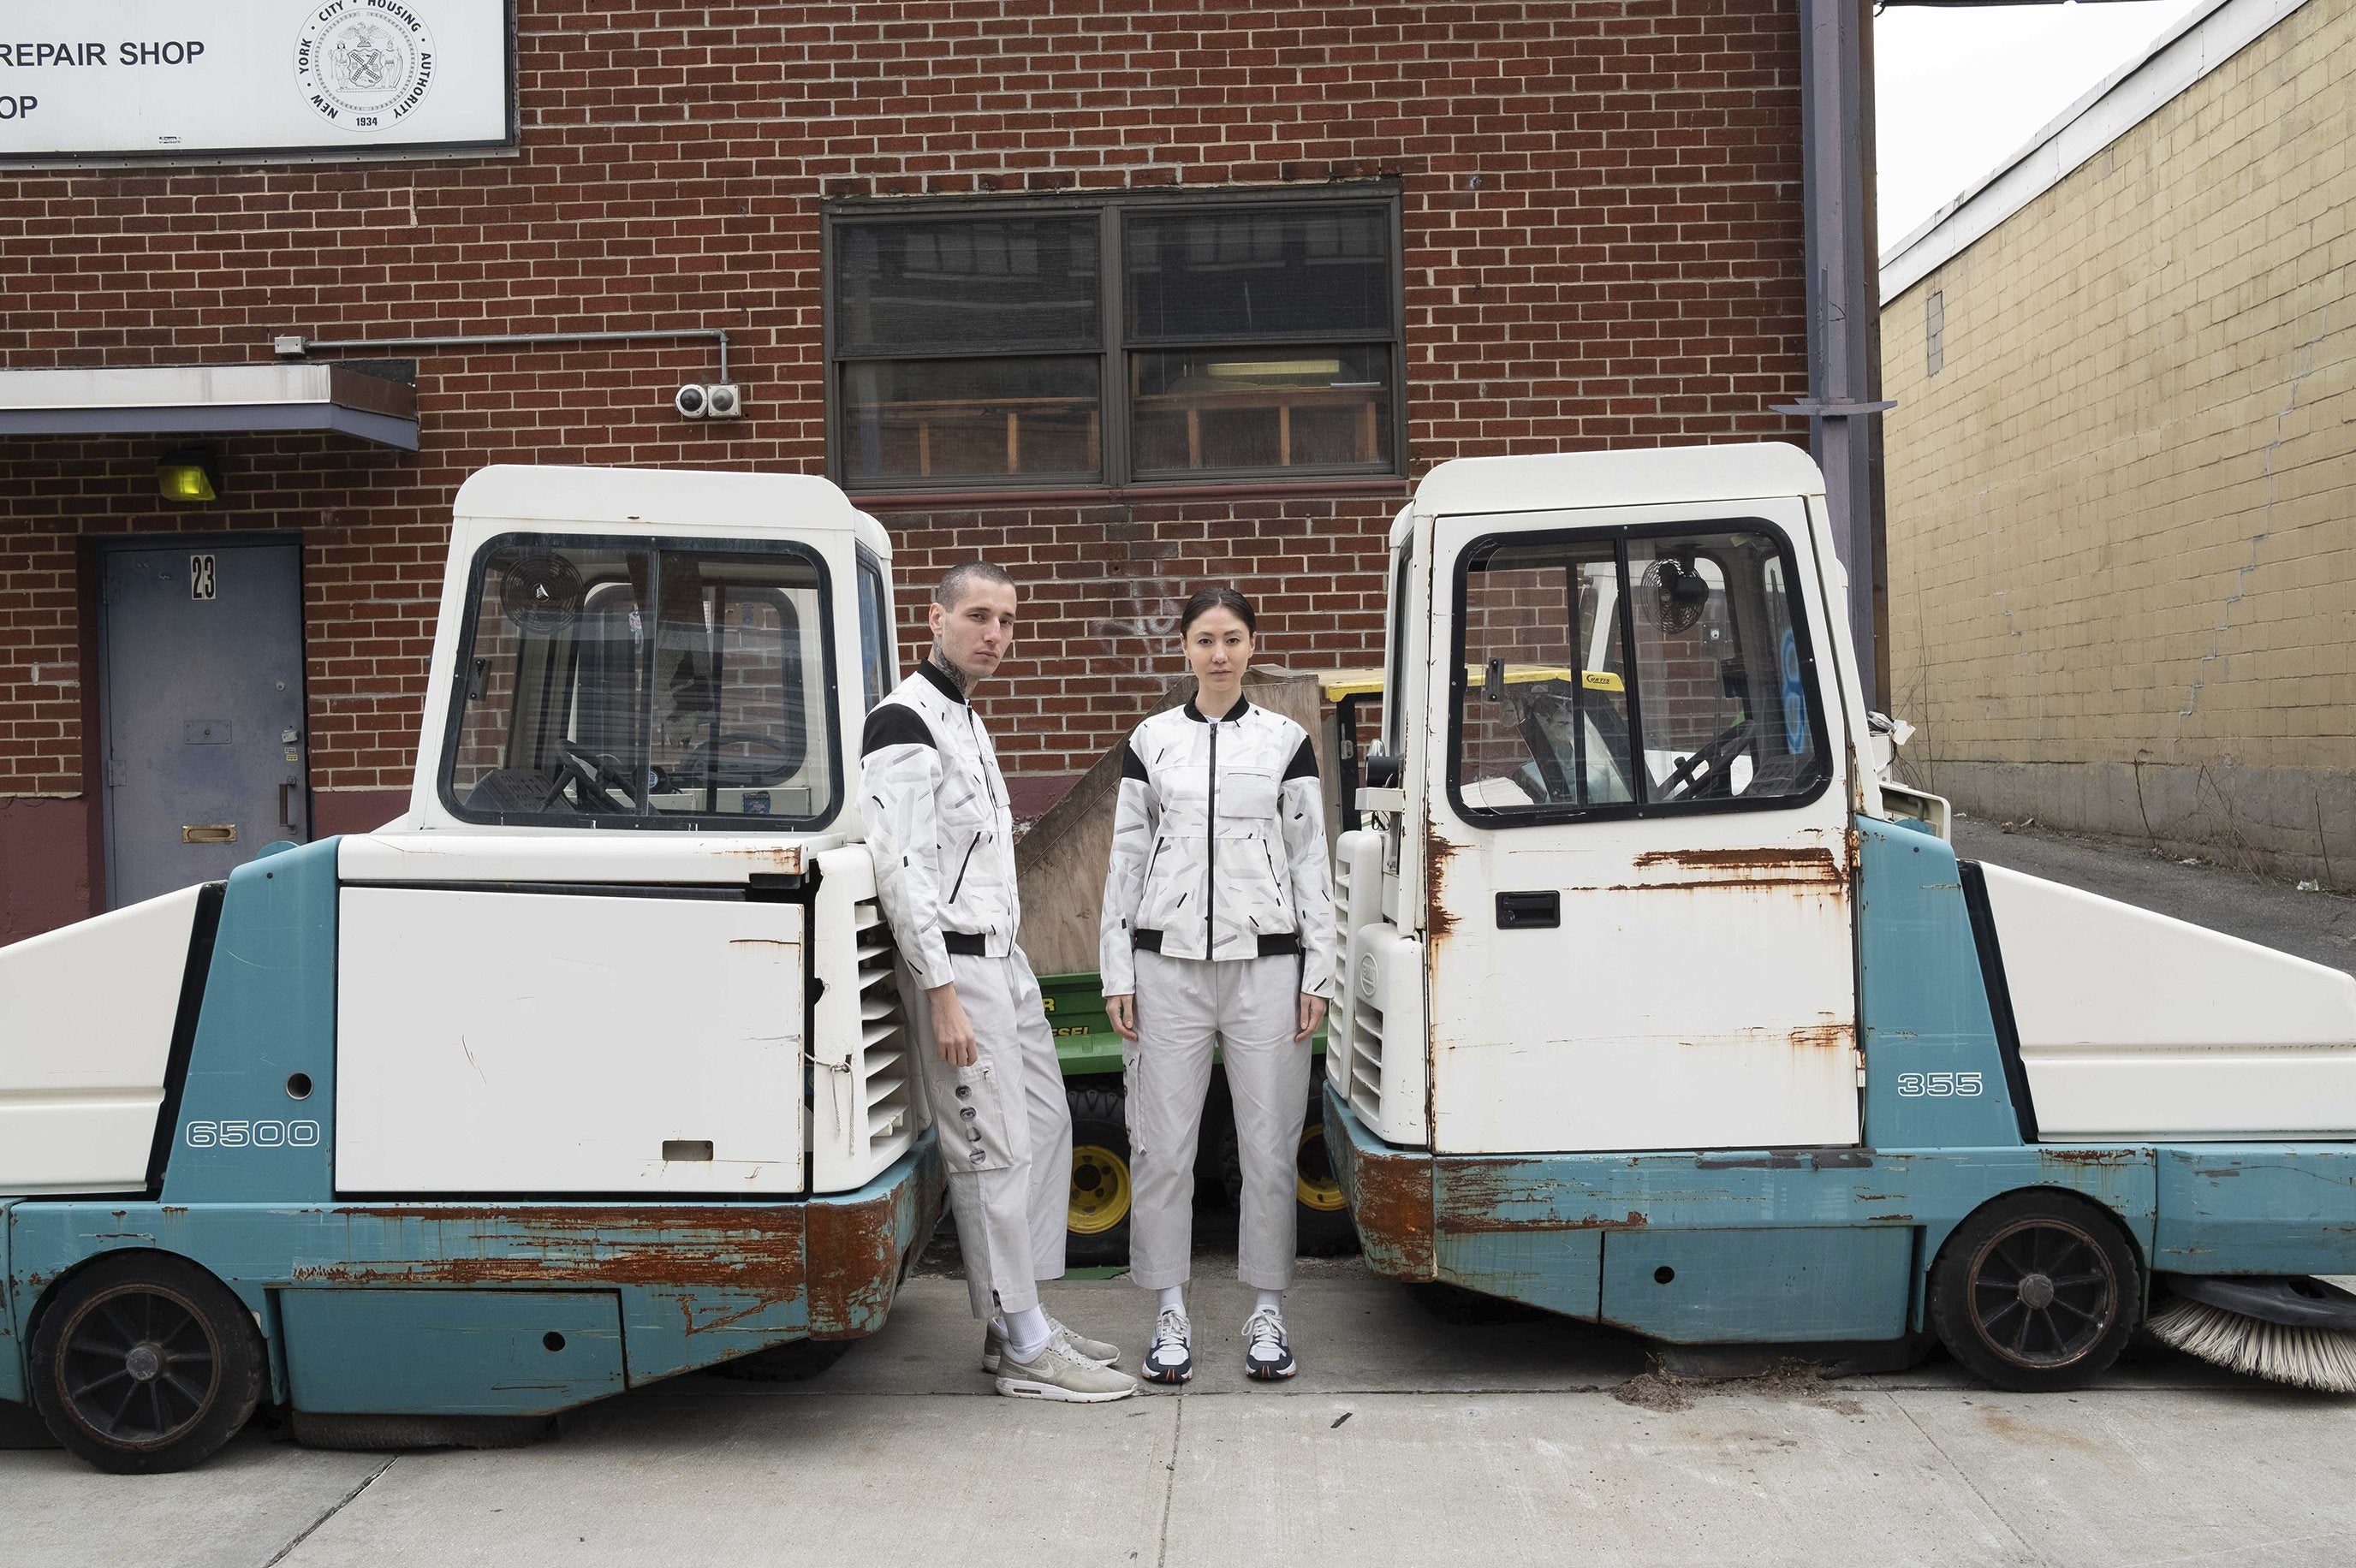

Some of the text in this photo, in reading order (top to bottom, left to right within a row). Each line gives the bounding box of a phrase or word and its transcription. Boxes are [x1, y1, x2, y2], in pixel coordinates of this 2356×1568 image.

[318, 0, 343, 21] CITY
[119, 41, 205, 66] SHOP
[298, 38, 312, 74] YORK
[393, 52, 431, 119] AUTHORITY
[311, 94, 338, 119] NEW
[356, 116, 378, 127] 1934
[192, 555, 215, 598] 23
[1898, 1072, 1983, 1096] 355
[186, 1120, 320, 1148] 6500
